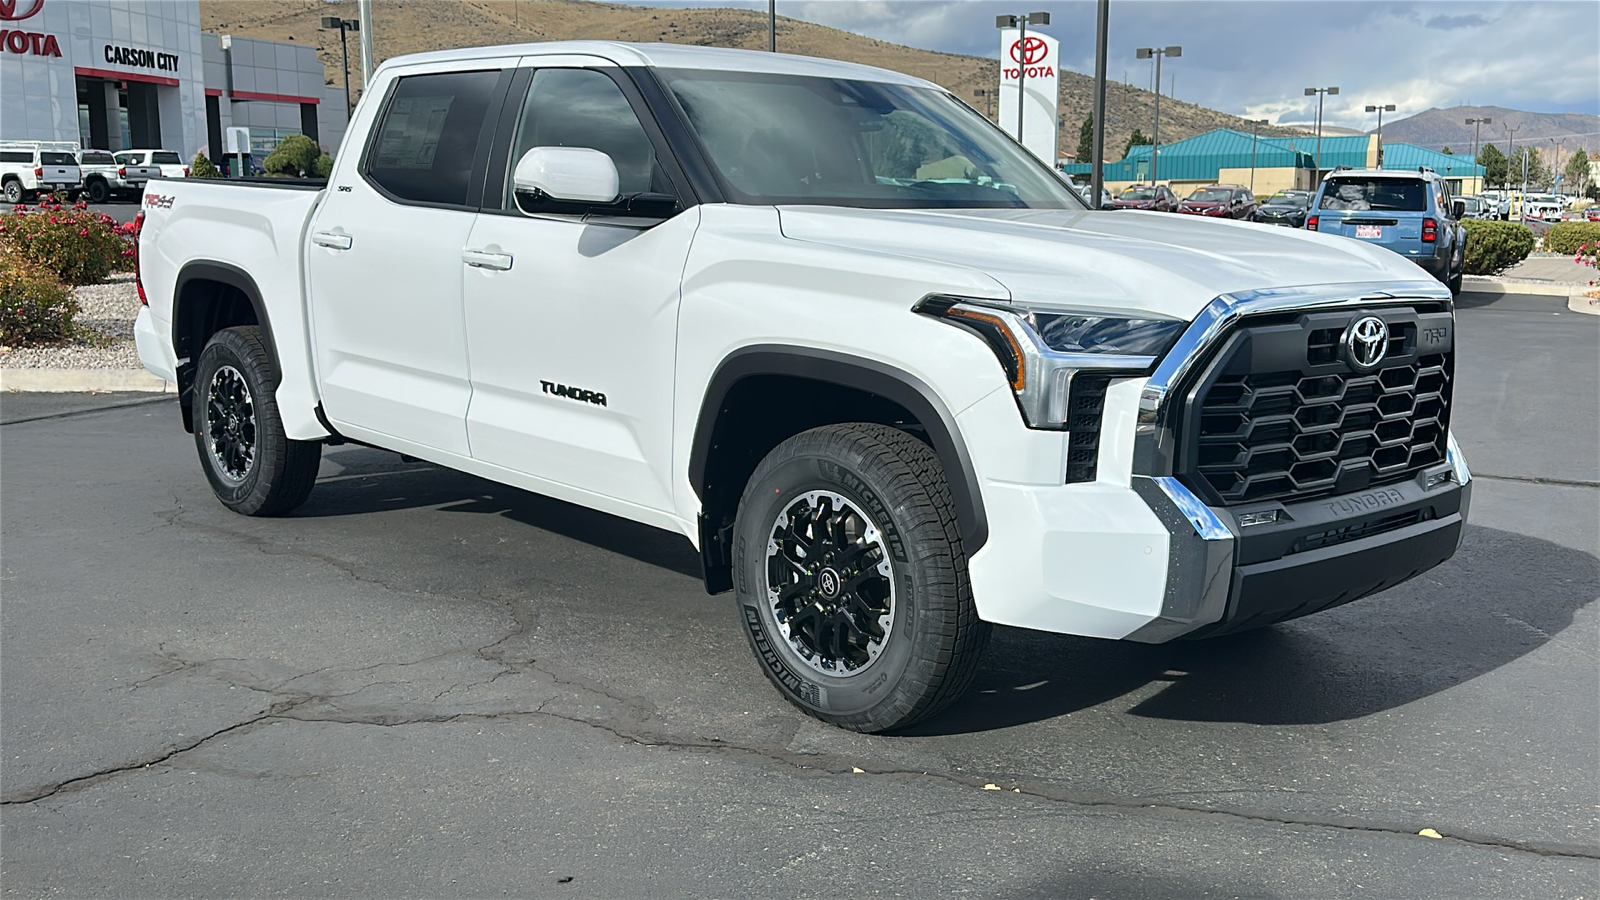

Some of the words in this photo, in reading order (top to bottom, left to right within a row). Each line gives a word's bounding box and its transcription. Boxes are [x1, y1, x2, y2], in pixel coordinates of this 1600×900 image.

[104, 45, 155, 69] CARSON
[157, 52, 179, 72] CITY
[1423, 327, 1447, 344] TRD
[540, 379, 607, 407] TUNDRA
[843, 473, 905, 558] MICHELIN
[1322, 488, 1405, 516] TUNDRA
[746, 608, 800, 691] MICHELIN
